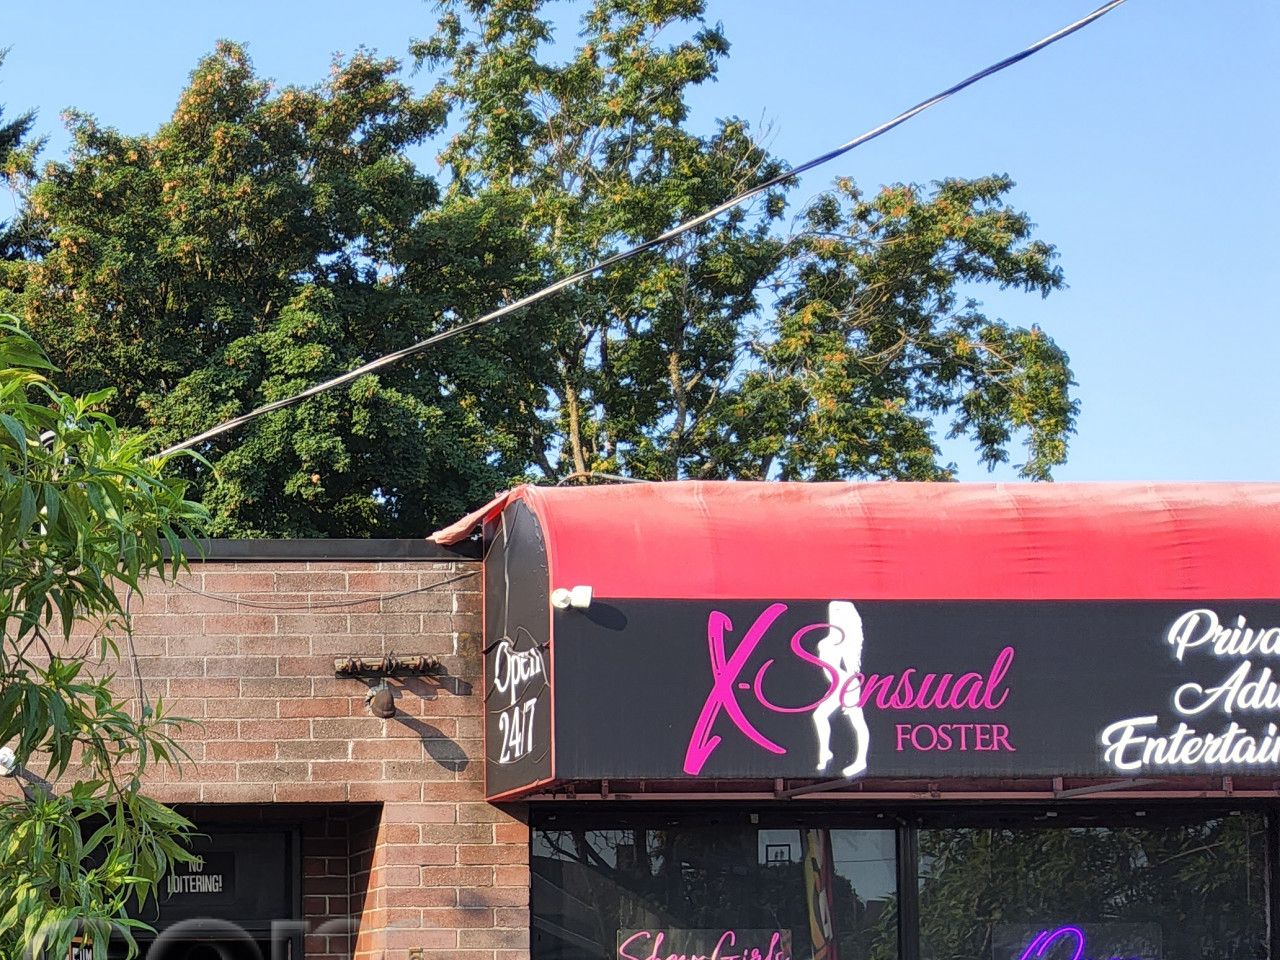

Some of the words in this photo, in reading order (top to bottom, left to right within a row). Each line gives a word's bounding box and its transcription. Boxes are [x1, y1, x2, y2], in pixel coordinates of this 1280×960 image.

[494, 640, 541, 706] Open
[498, 697, 538, 764] 24/7
[895, 723, 1016, 752] FOSTER
[188, 855, 204, 873] NO
